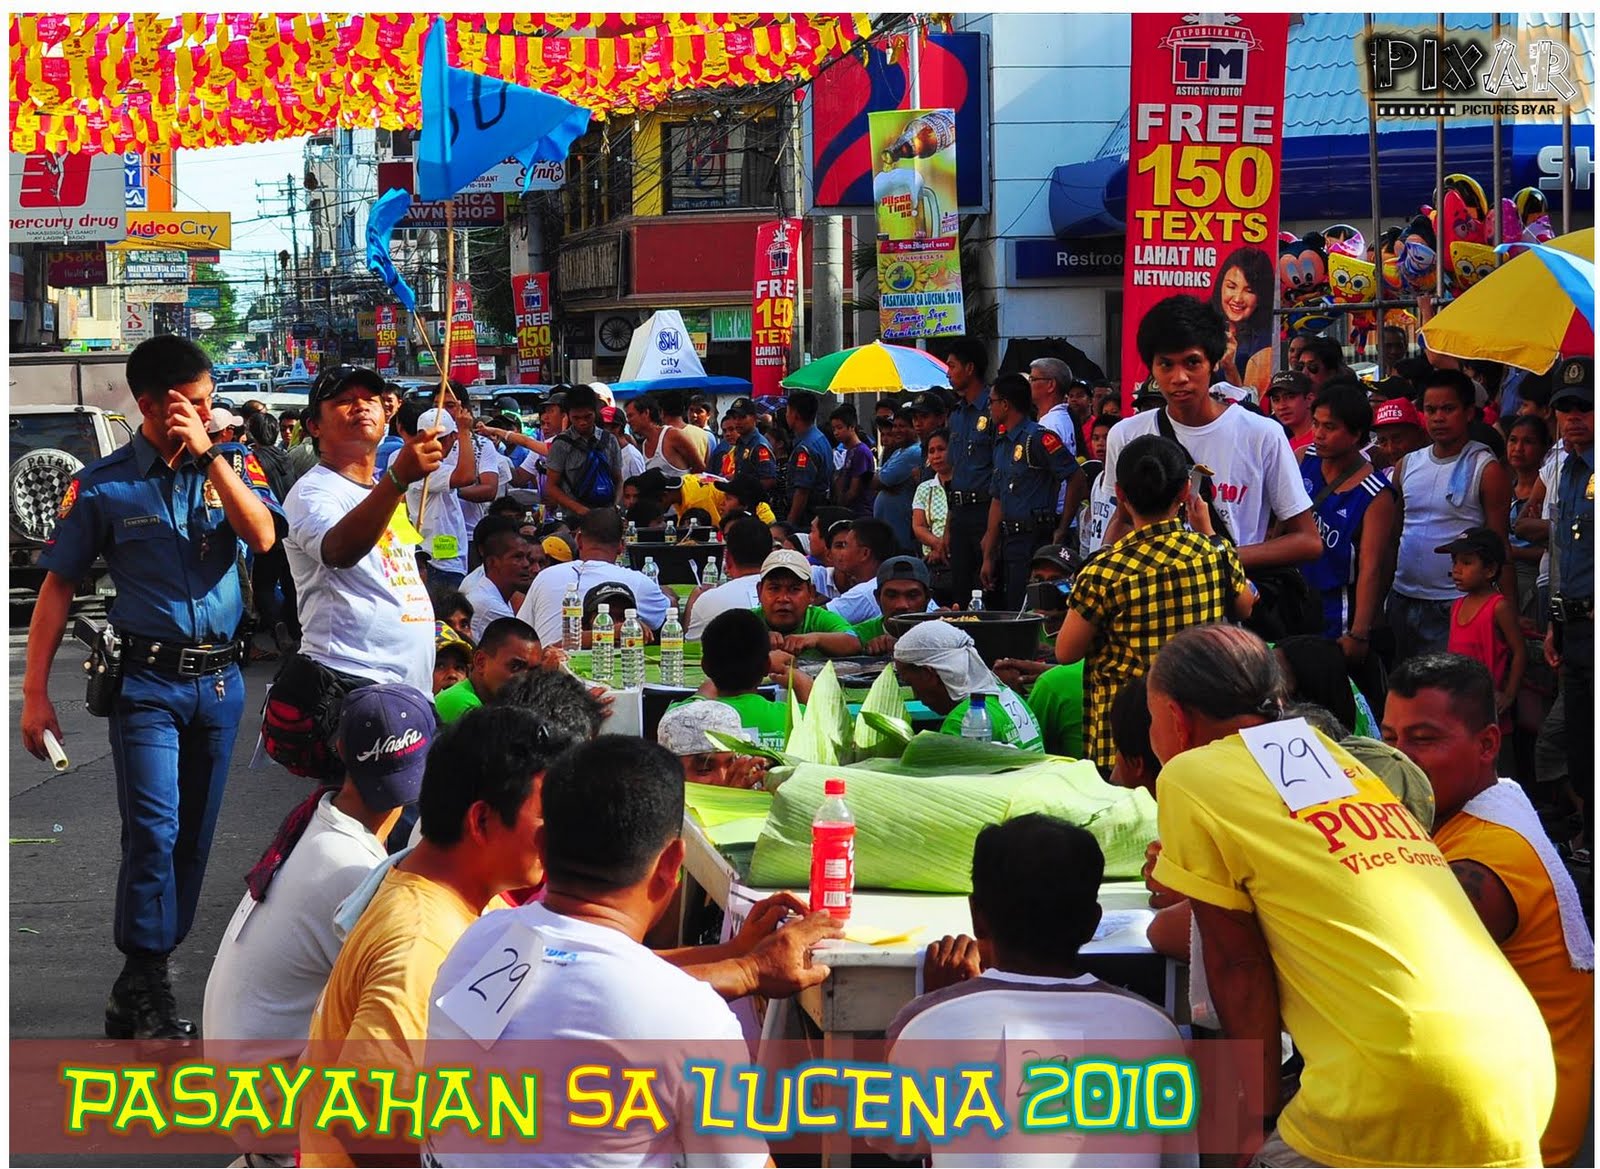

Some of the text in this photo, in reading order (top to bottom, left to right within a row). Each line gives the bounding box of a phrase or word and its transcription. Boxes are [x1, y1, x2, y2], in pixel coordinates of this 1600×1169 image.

[1176, 27, 1247, 39] REPUBLIKA NG
[1180, 48, 1244, 80] TM
[1176, 86, 1242, 96] ASTIG TAYO DITO!
[1137, 103, 1275, 144] FREE
[1138, 144, 1274, 209] 150
[881, 193, 911, 206] Pilsen
[403, 206, 497, 219] AWNSHOP
[888, 201, 911, 214] Time
[901, 210, 912, 218] na
[79, 214, 119, 229] drug
[1135, 210, 1268, 243] TEXTS
[898, 242, 912, 250] San
[913, 240, 935, 250] Miguel
[1056, 251, 1124, 266] Restroo
[1134, 245, 1217, 267] LAHAT NG
[1133, 270, 1211, 287] NETWORKS
[924, 292, 946, 306] LUCENA
[516, 312, 550, 327] FREE
[893, 312, 924, 323] Summer
[377, 323, 396, 331] FREE
[377, 330, 397, 341] 150
[518, 325, 551, 347] 150
[519, 346, 552, 358] TEXTS
[661, 356, 680, 368] city
[28, 455, 74, 474] PATRO
[1263, 737, 1332, 788] 29
[1340, 846, 1448, 875] Vice Gover
[468, 947, 531, 1014] 29
